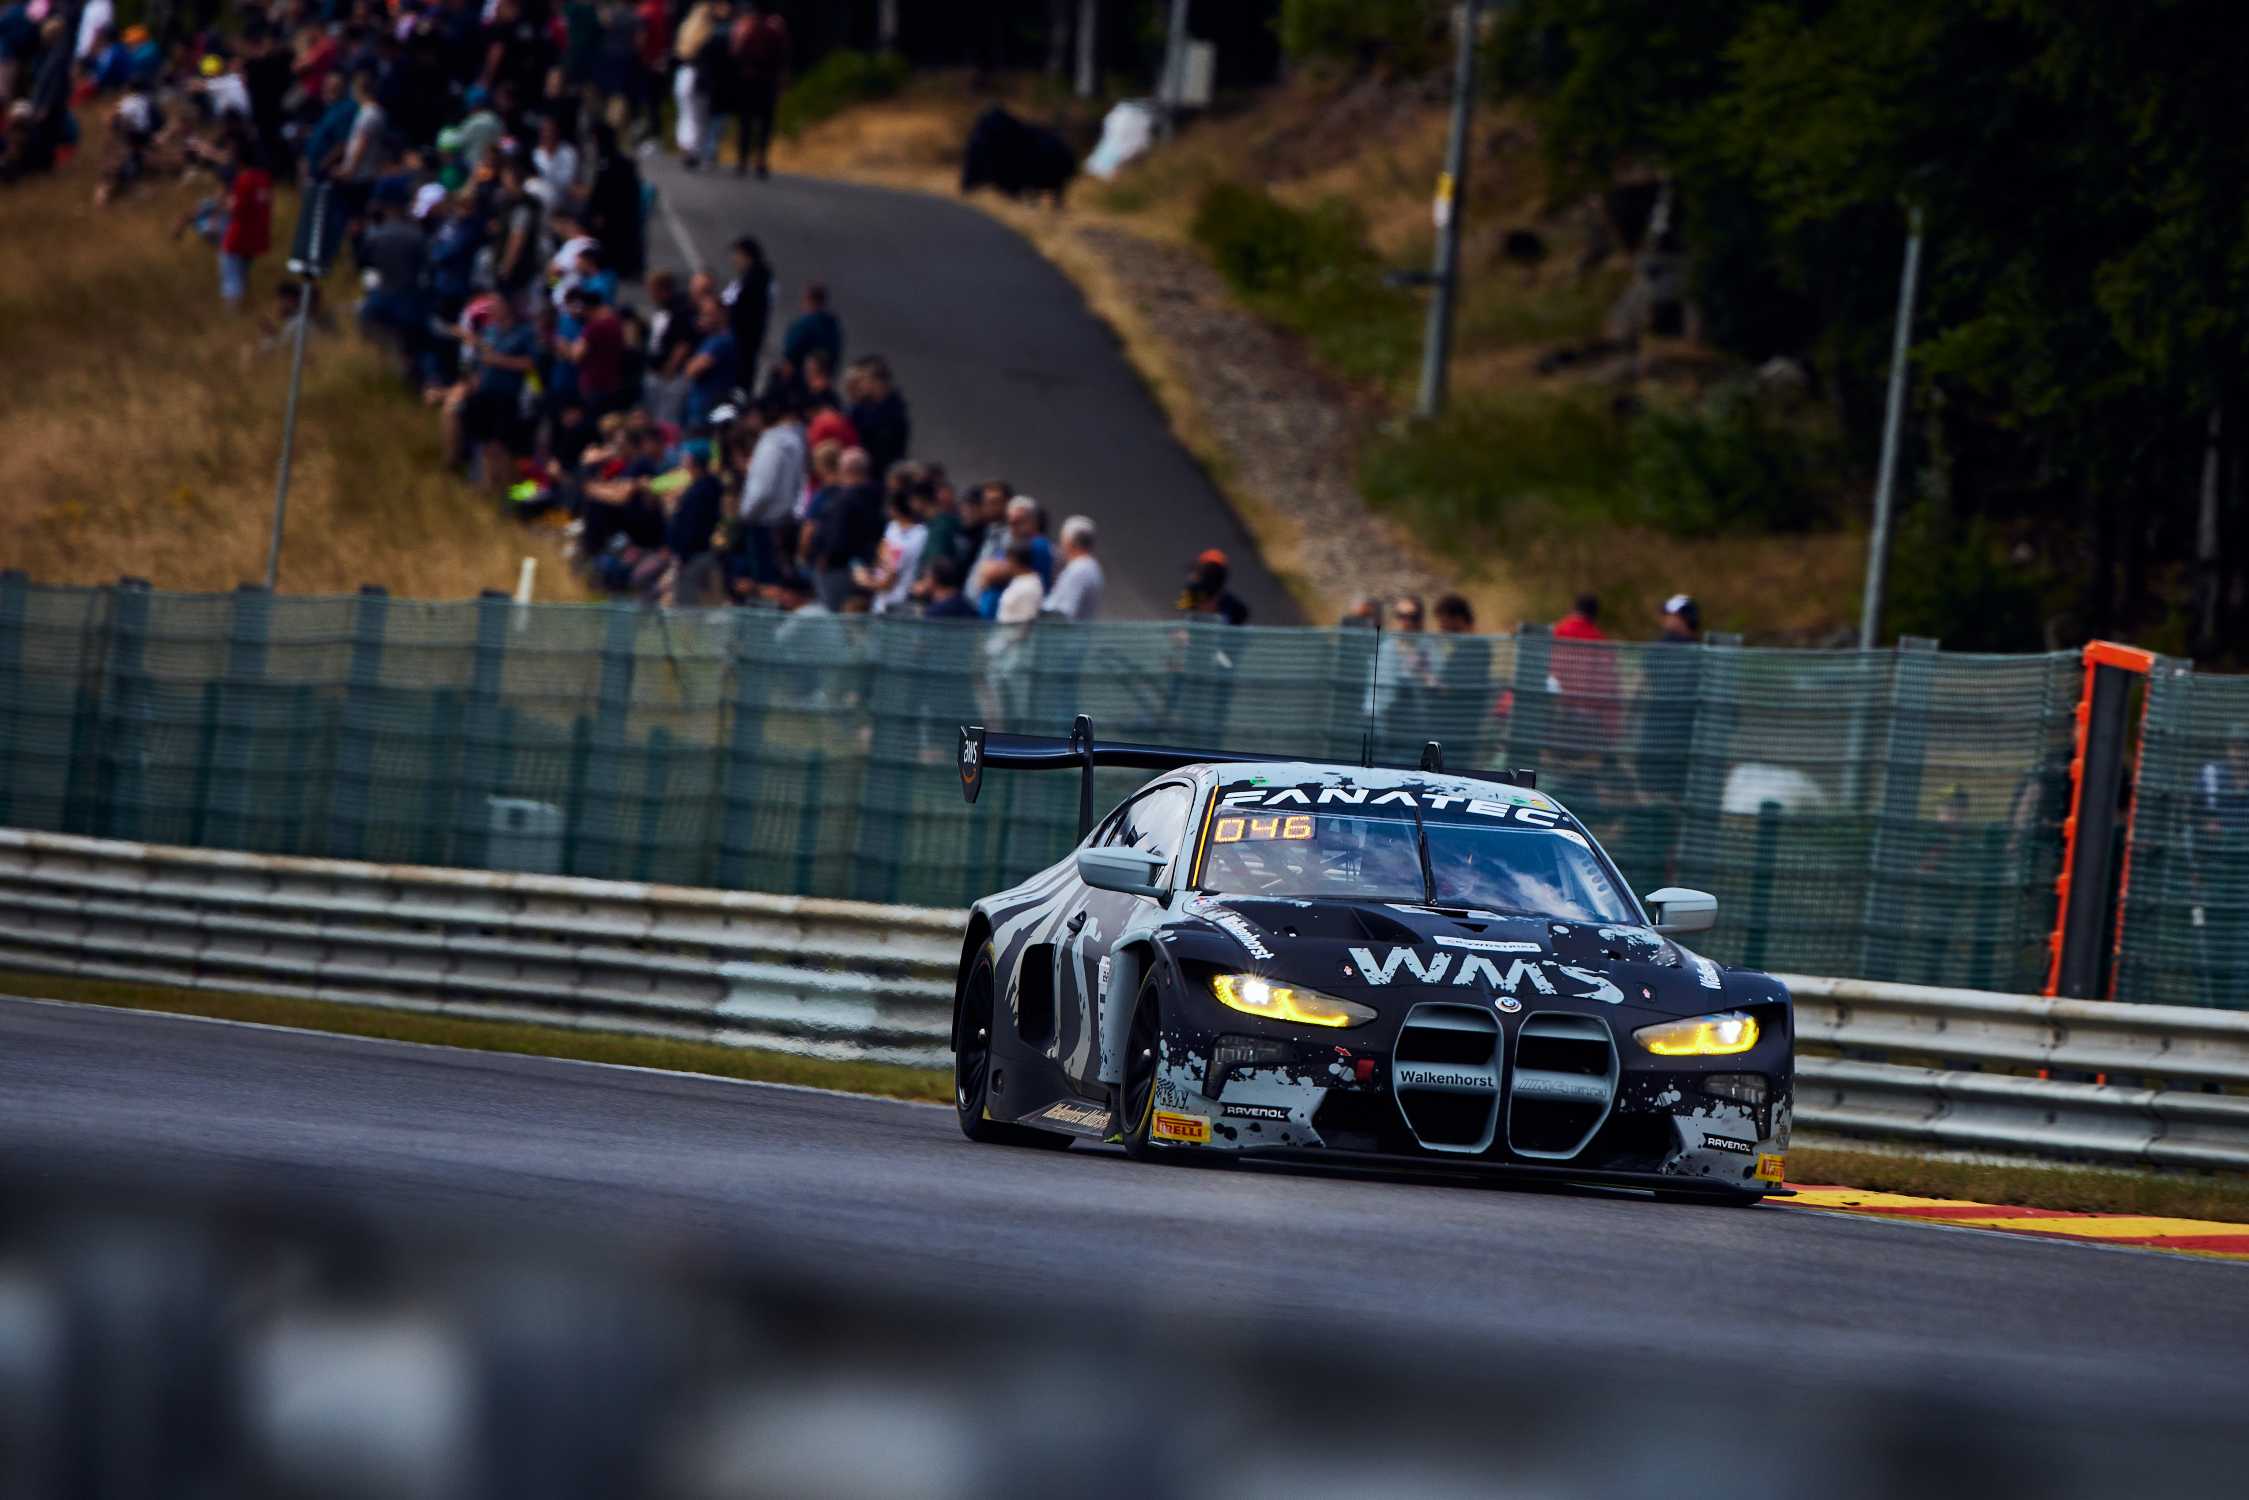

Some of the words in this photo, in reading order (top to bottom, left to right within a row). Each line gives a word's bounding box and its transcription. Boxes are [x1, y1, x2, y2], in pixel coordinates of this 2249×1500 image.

[963, 739, 978, 765] aws
[1221, 788, 1560, 828] FANATEC
[1214, 815, 1313, 843] 046
[1348, 945, 1625, 1005] WMS
[1400, 1070, 1495, 1088] Walkenhorst
[1226, 1106, 1286, 1119] RAVENOL
[1157, 1115, 1203, 1138] PIRELLI
[1707, 1137, 1751, 1152] RAVENOL
